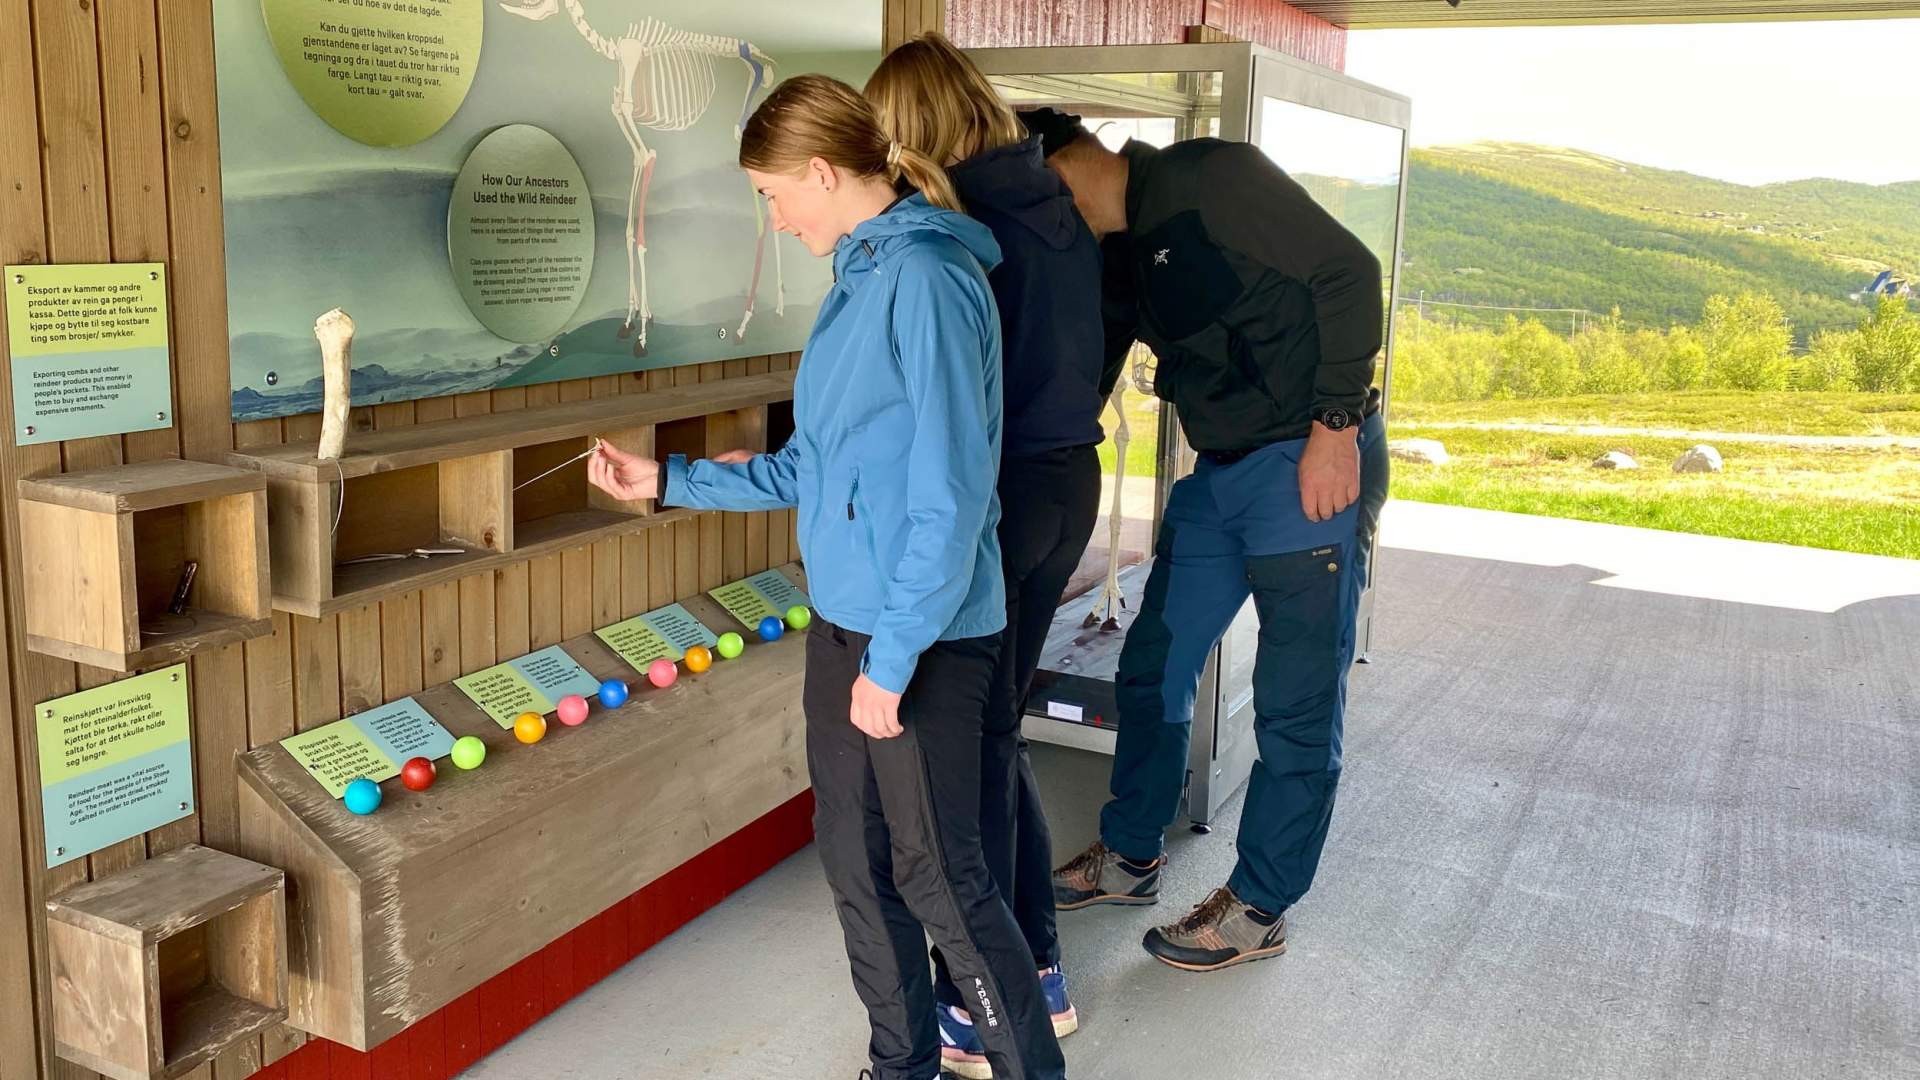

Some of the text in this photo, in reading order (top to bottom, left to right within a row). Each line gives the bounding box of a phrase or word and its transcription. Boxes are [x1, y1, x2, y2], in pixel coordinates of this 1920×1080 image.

[320, 22, 336, 32] Kan
[351, 28, 375, 38] gjette
[377, 28, 405, 40] hvilken
[407, 32, 444, 44] kroppsdel
[303, 35, 360, 50] gjenstandene
[372, 42, 392, 55] laget
[394, 46, 407, 55] av?
[409, 46, 419, 56] Se
[420, 47, 448, 60] fargene
[450, 51, 459, 61] på
[304, 52, 341, 65] tegninga
[344, 57, 354, 66] og
[356, 55, 369, 66] dra
[376, 58, 397, 68] tauet
[410, 61, 424, 71] tror
[427, 62, 438, 72] har
[440, 64, 460, 76] riktig
[328, 68, 354, 80] farge.
[354, 70, 377, 83] Langt
[379, 73, 392, 82] tau
[402, 74, 422, 86] riktig
[424, 78, 441, 87] svar.
[348, 84, 365, 95] kort
[367, 87, 380, 95] tau
[389, 88, 405, 99] galt
[406, 91, 424, 99] svar.
[482, 174, 569, 188] How Our Ancestors
[474, 192, 577, 205] Used the Wild Reindeer
[28, 286, 60, 295] Eksport
[29, 298, 69, 308] produkter
[112, 296, 138, 304] penger
[82, 308, 107, 318] gjorde
[30, 323, 53, 332] kjøpe
[68, 321, 89, 329] bytte
[91, 319, 99, 327] til
[31, 336, 48, 344] ting
[69, 330, 99, 341] brosjer/
[102, 329, 136, 339] smykker.
[33, 370, 66, 379] Exporting
[63, 378, 92, 386] products
[34, 389, 62, 398] people's
[63, 387, 90, 396] pockets.
[36, 404, 106, 416] expensive ornaments.
[63, 707, 102, 724] Reinskjøtt
[118, 693, 151, 707] livsviktig
[64, 703, 154, 734] mat for steinalderfolket.
[65, 710, 162, 746] Kjøttet ble tørka, røkt eller
[65, 746, 84, 756] salta
[86, 742, 97, 750] for
[109, 734, 121, 742] det
[123, 727, 144, 738] skulle
[146, 720, 165, 730] holde
[66, 750, 109, 767] seg lengre.
